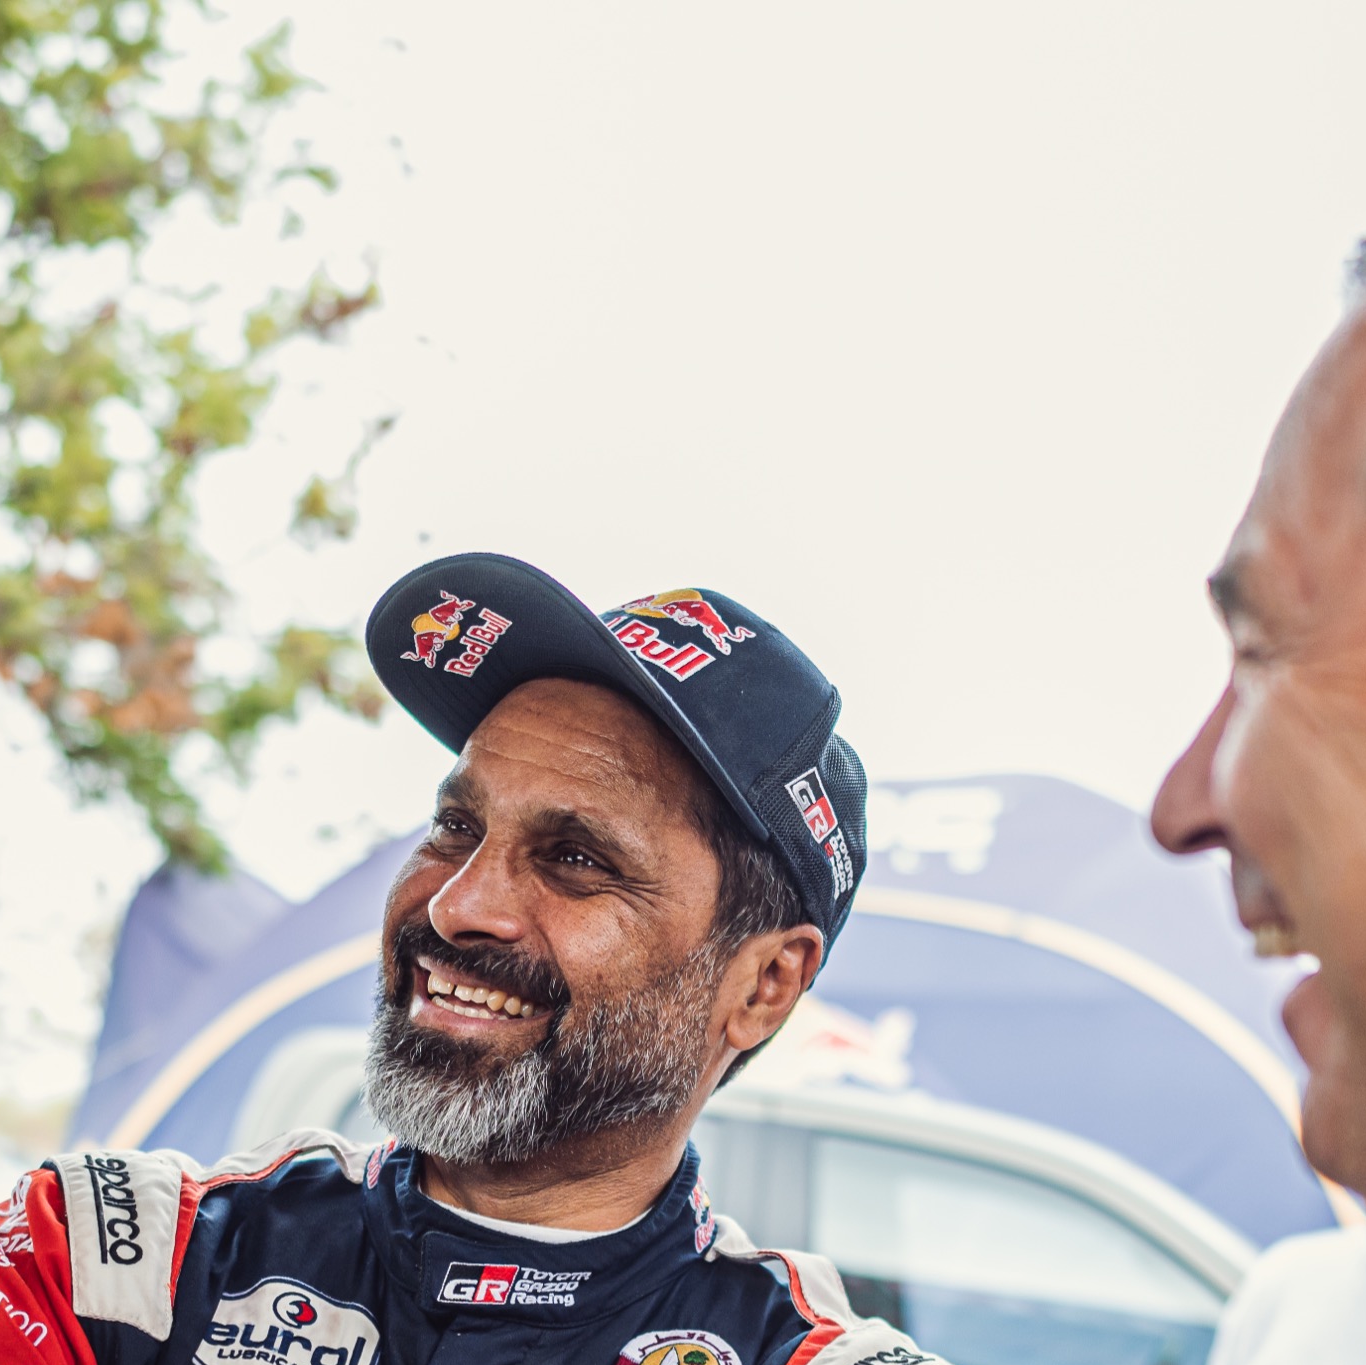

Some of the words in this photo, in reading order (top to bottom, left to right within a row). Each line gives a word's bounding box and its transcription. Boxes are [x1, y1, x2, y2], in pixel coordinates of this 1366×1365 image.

[467, 608, 512, 645] Bull
[444, 636, 492, 677] Red
[614, 619, 716, 682] Bull
[791, 779, 829, 840] GR
[84, 1156, 143, 1265] sparco
[443, 1278, 510, 1303] GR
[510, 1292, 576, 1307] Racing
[514, 1279, 580, 1293] GAZOO
